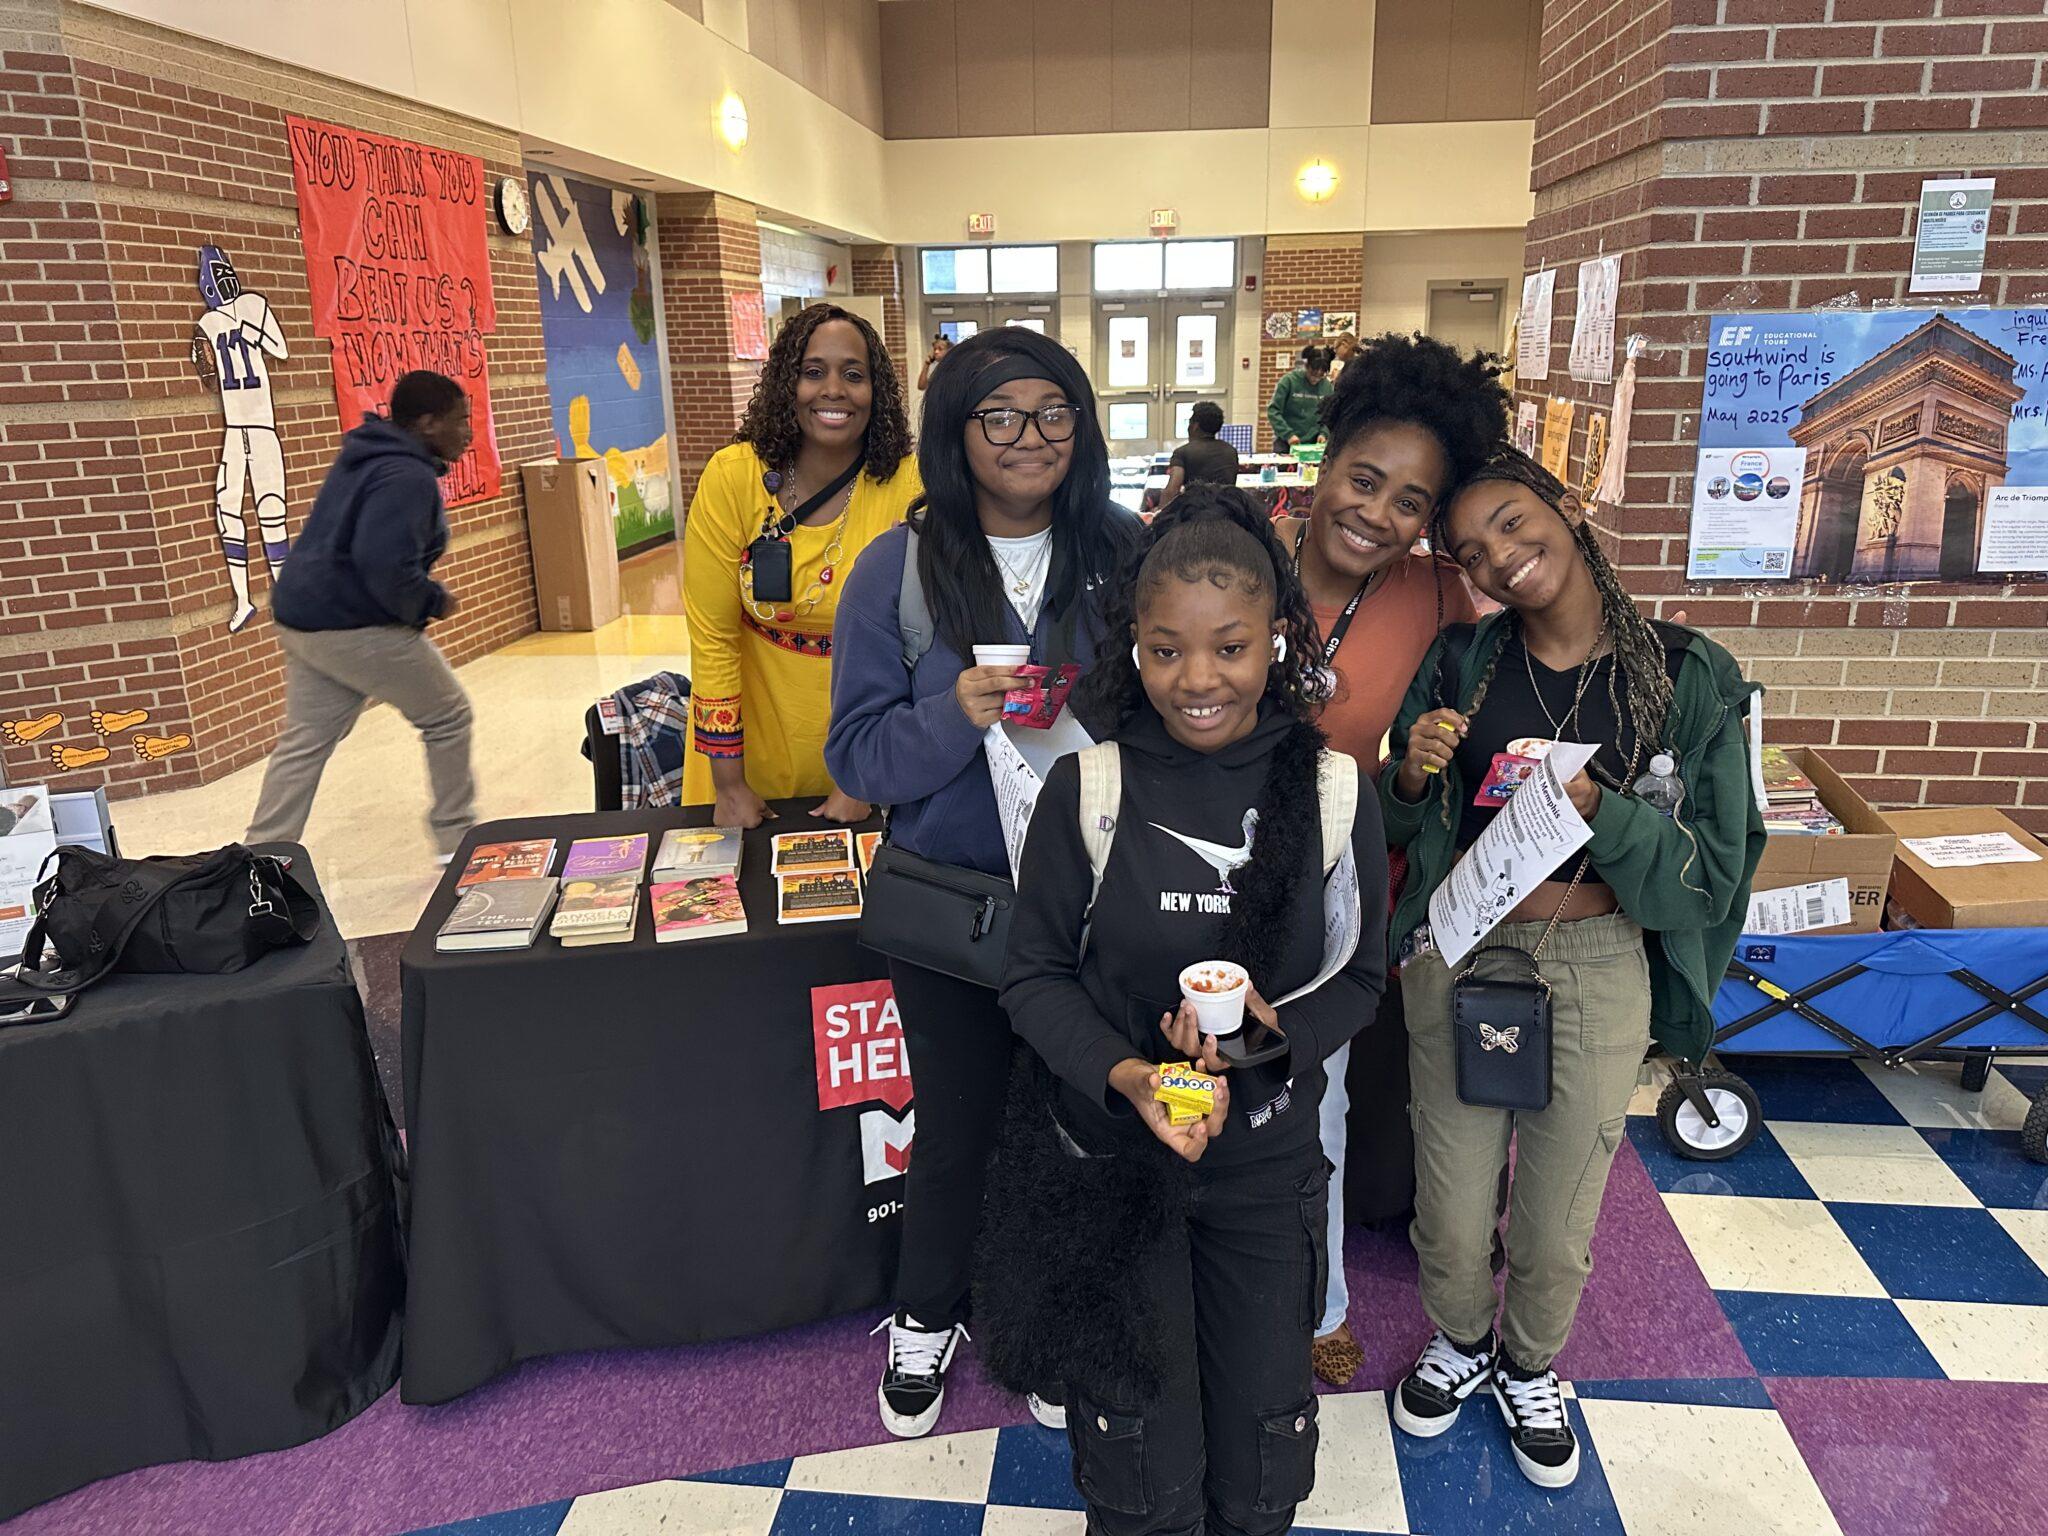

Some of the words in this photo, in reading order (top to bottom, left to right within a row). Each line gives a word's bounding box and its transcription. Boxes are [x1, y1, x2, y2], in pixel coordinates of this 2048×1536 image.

[292, 126, 355, 190] YOU
[357, 138, 426, 197] THINK
[430, 152, 476, 205] YOU
[363, 197, 427, 260] CAN
[975, 215, 993, 230] EXIT
[1154, 210, 1174, 226] EXIT
[334, 256, 408, 325] BEAT
[1719, 326, 1753, 346] EF
[217, 328, 261, 390] 11
[341, 331, 410, 387] NOW
[413, 327, 484, 378] THAT'S
[1821, 344, 1836, 363] is
[1708, 367, 1748, 398] going
[1754, 367, 1771, 386] to
[1779, 364, 1831, 400] Paris
[2018, 363, 2038, 379] Ms.
[1707, 407, 1737, 430] May
[1747, 404, 1799, 423] 2025
[2013, 405, 2042, 422] Mrs.
[1540, 781, 1561, 819] Memphis
[1544, 811, 1559, 836] dedicated
[472, 856, 499, 865] WHAT
[1160, 892, 1191, 911] NEW
[1196, 894, 1231, 913] YORK
[478, 917, 534, 925] TESTING
[1162, 1076, 1215, 1091] DOTS
[867, 1200, 904, 1223] 901-
